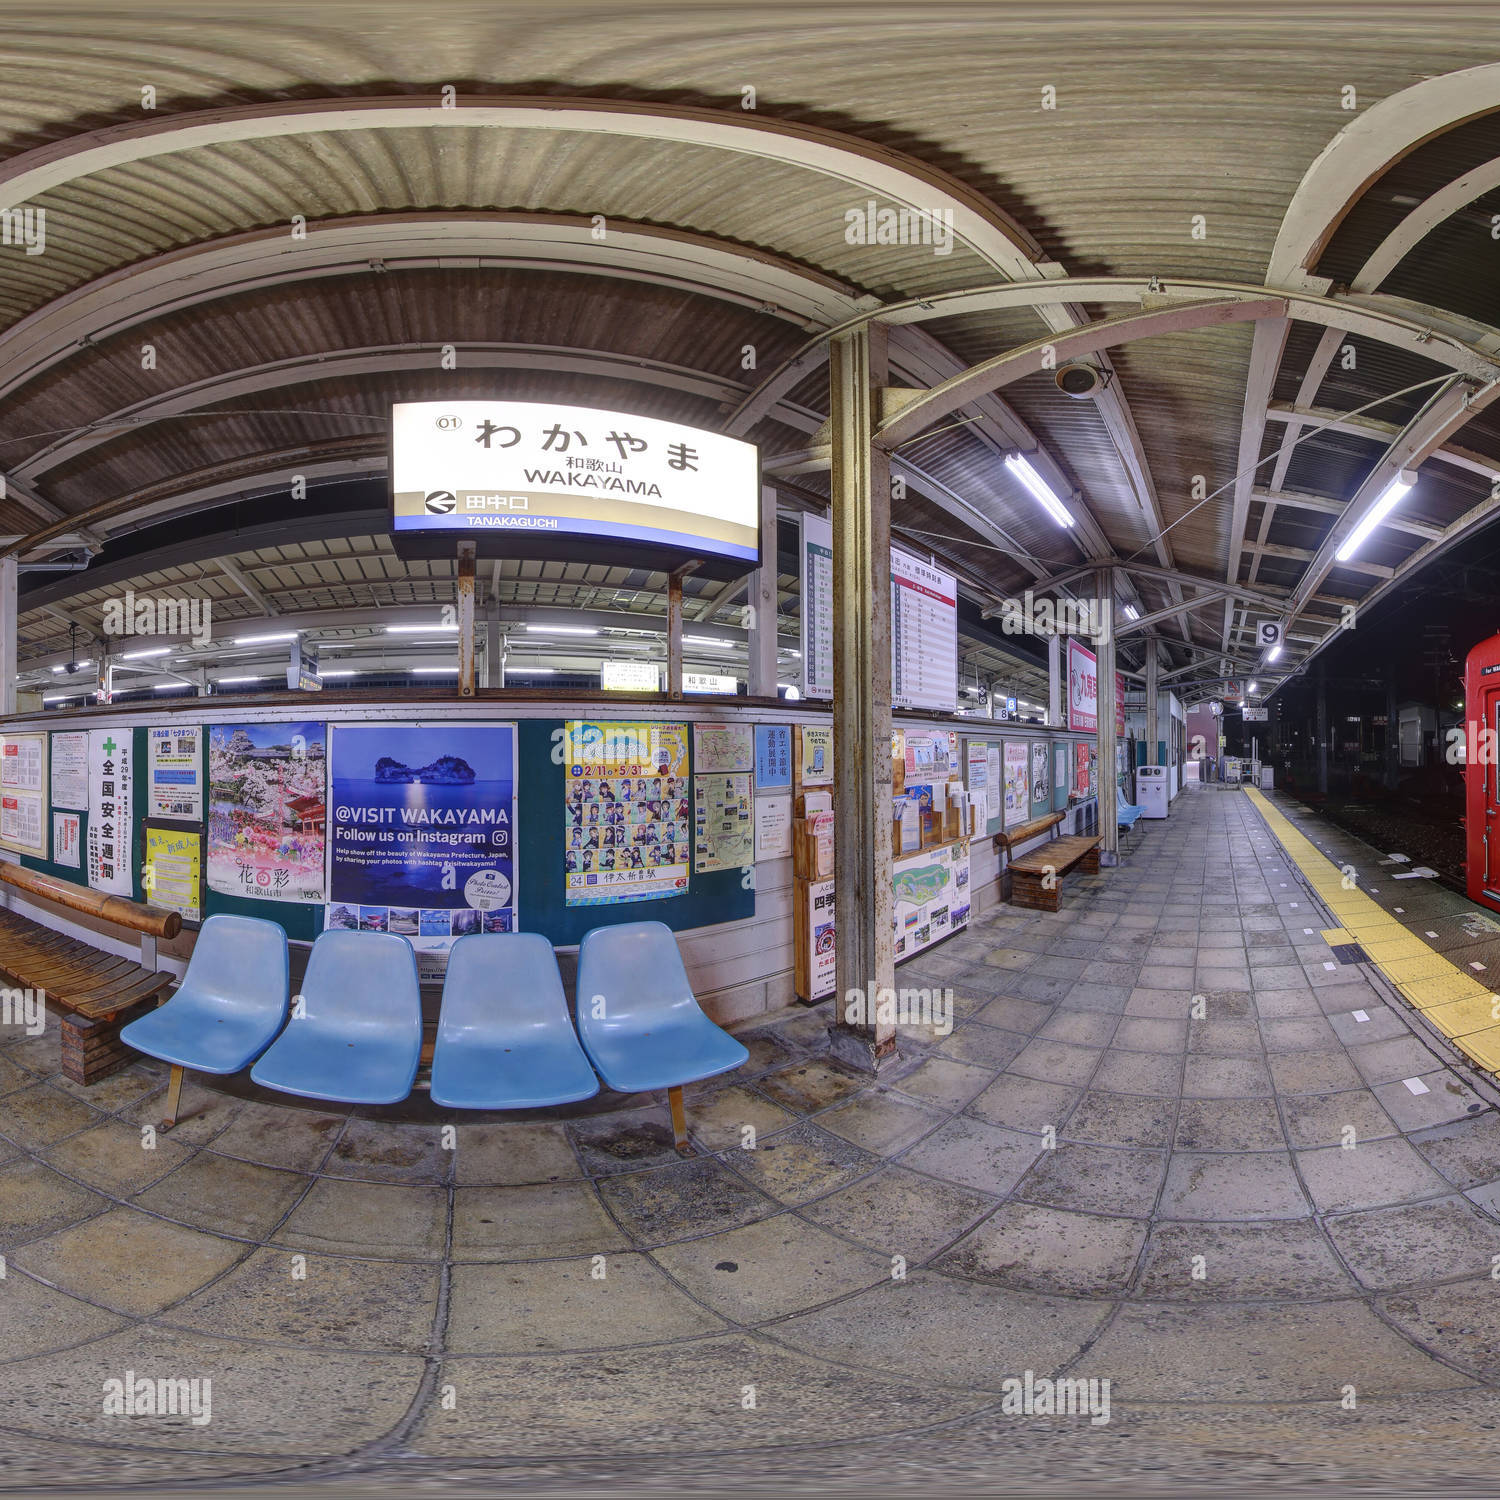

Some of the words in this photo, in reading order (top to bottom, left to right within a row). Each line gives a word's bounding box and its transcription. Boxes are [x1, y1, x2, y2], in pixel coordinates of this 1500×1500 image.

[475, 419, 700, 472] わかやま
[566, 456, 623, 475] 和歌山
[524, 468, 662, 498] WAKAYAMA
[466, 495, 528, 510] 田中口
[466, 516, 558, 529] TANAKAGUCHI
[1262, 624, 1278, 644] 9
[688, 676, 718, 686] 和歌山
[1008, 700, 1014, 709] 8
[1001, 710, 1007, 718] 8
[584, 766, 606, 776] 2/11
[620, 766, 642, 776] 5/31
[102, 760, 115, 880] 全国安全週間
[336, 806, 396, 823] @VISIT
[400, 808, 509, 824] WAKAYAMA
[336, 827, 376, 842] Follow
[379, 832, 394, 842] us
[398, 832, 414, 842] on
[416, 830, 486, 845] Instagram
[570, 876, 582, 886] 24
